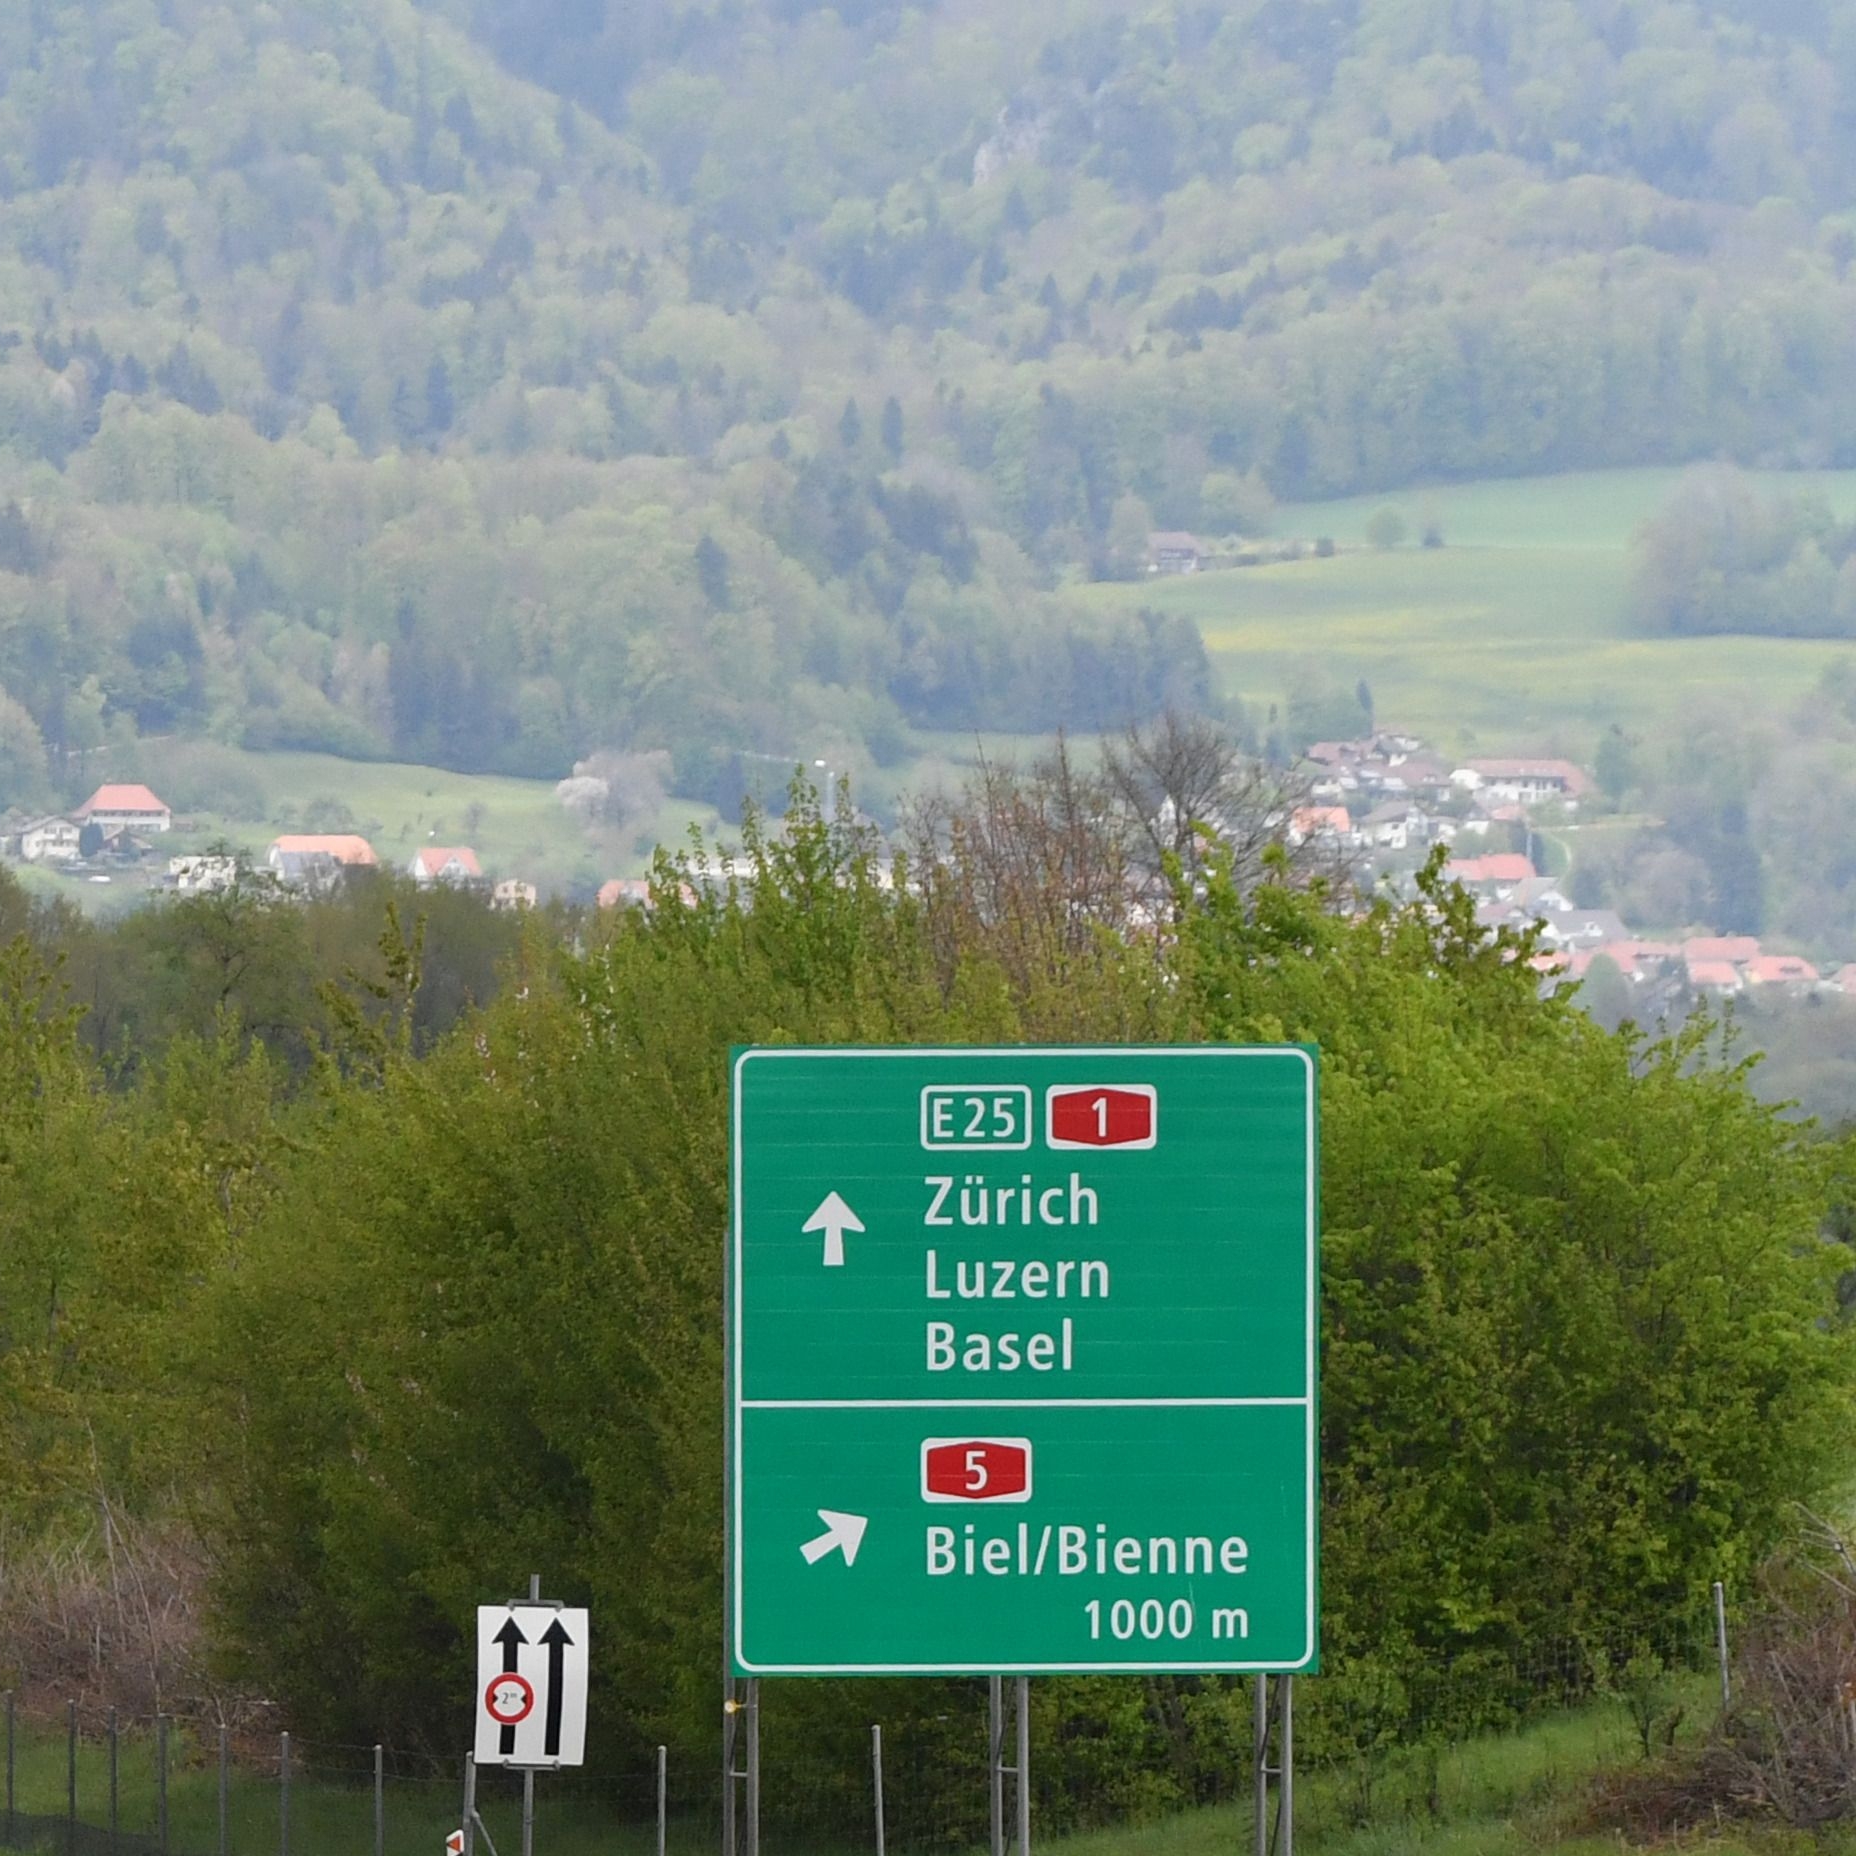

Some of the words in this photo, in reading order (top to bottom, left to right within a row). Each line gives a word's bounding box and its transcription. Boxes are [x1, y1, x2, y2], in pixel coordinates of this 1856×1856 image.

[933, 1097, 1016, 1138] E25
[1091, 1096, 1108, 1138] 1
[924, 1173, 1099, 1226] Zürich
[924, 1250, 1110, 1299] Luzern
[924, 1318, 1073, 1371] Basel
[964, 1449, 988, 1491] 5
[924, 1522, 1249, 1576] Biel/Bienne
[1083, 1599, 1192, 1639] 1000
[1211, 1606, 1249, 1638] m
